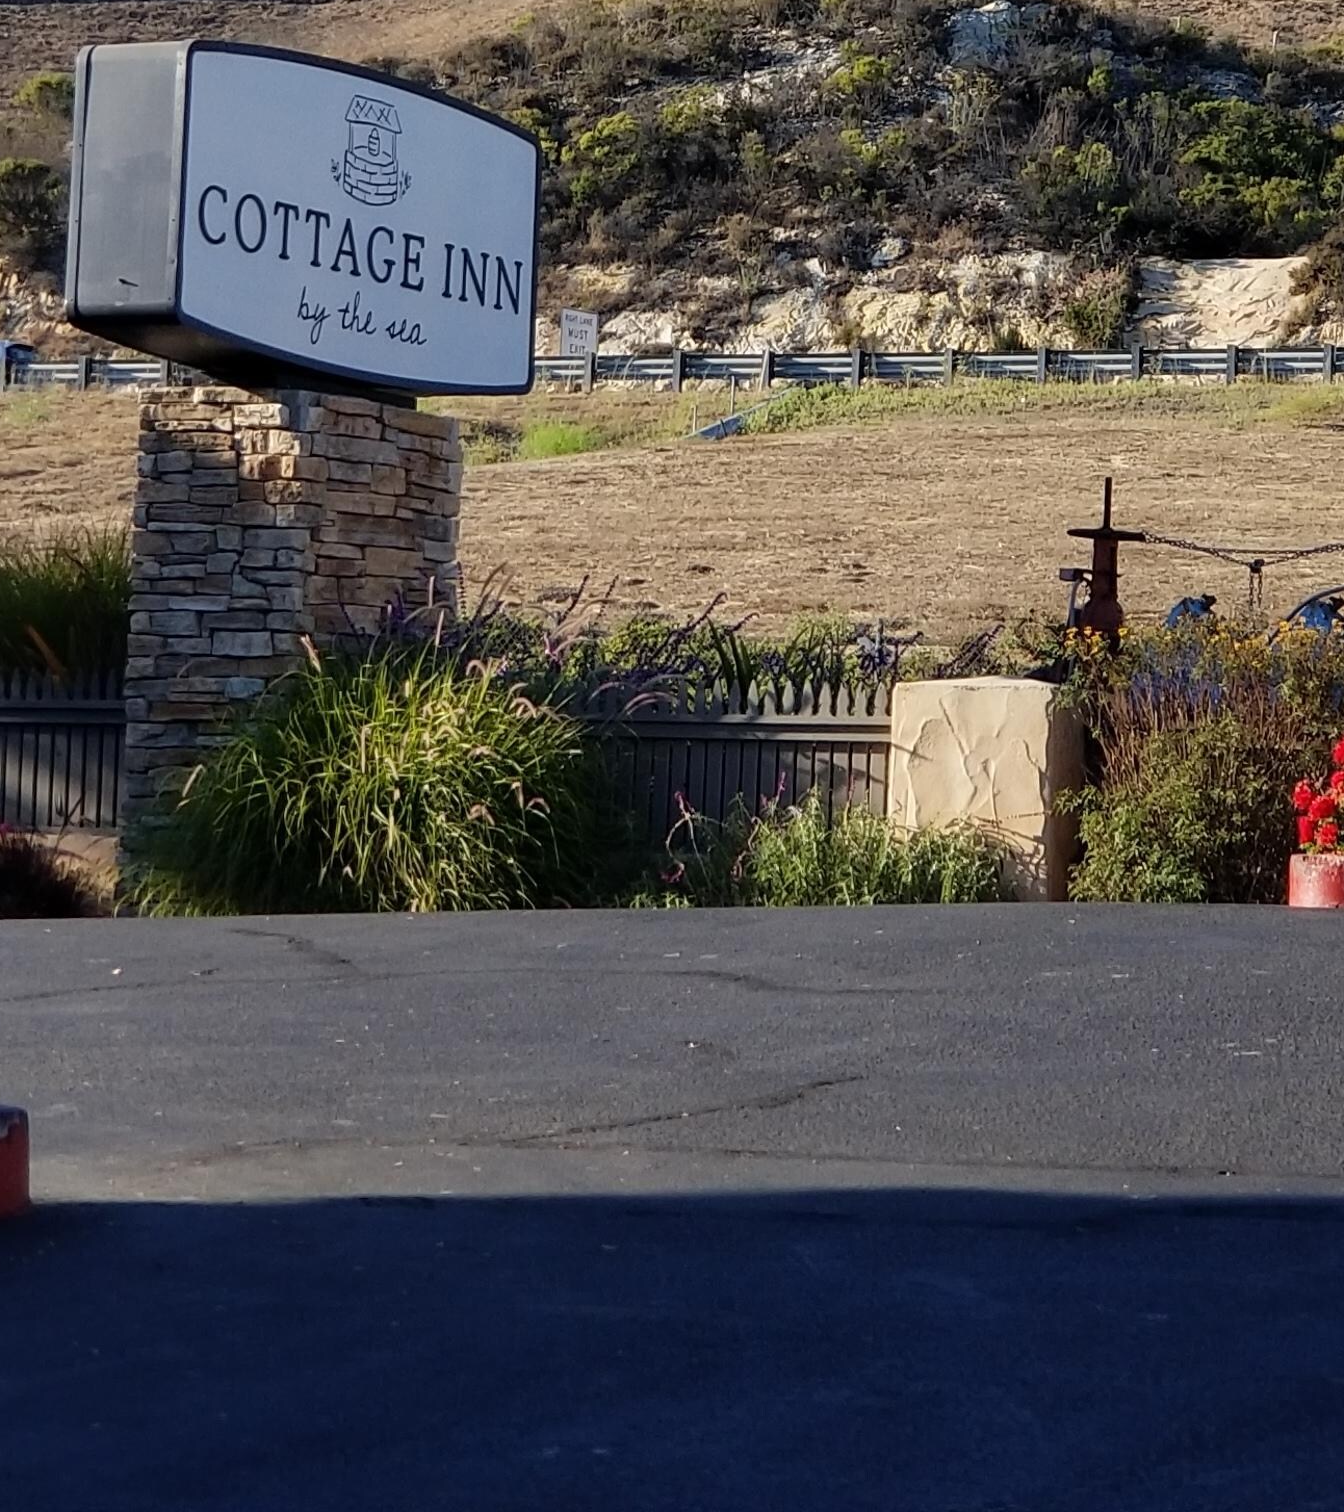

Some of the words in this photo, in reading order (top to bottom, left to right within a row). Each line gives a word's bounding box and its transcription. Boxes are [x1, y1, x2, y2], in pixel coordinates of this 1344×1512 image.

[198, 184, 425, 292] COTTAGE
[441, 243, 524, 316] INN
[297, 286, 332, 345] by
[337, 290, 377, 335] the
[385, 318, 428, 346] sea
[568, 327, 588, 342] MUST
[569, 343, 586, 355] EXIT
